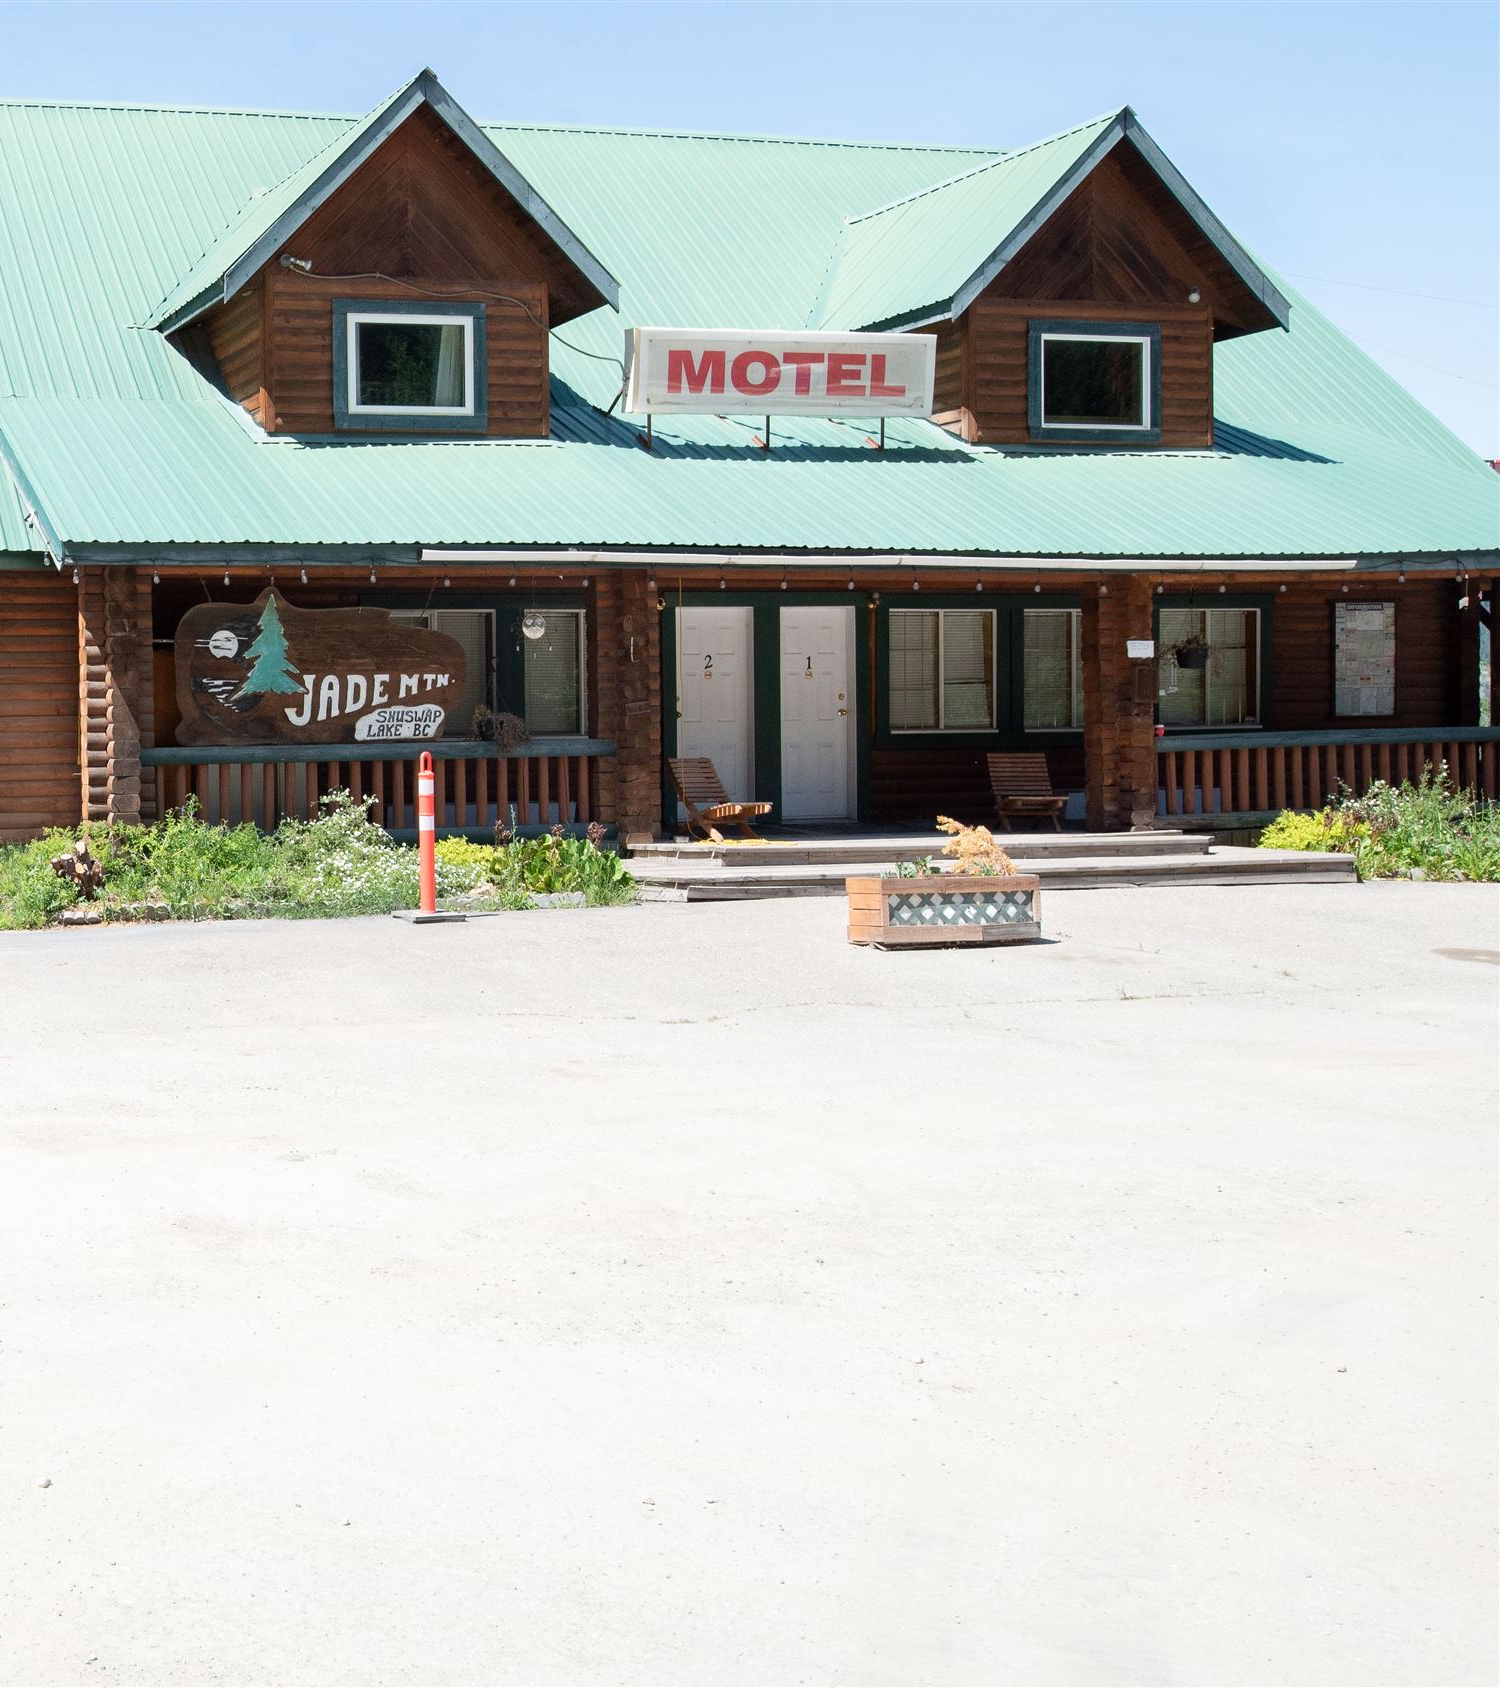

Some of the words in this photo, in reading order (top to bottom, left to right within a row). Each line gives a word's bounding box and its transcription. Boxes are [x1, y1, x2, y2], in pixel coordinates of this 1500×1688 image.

[667, 349, 906, 397] MOTEL
[704, 654, 713, 670] 2
[806, 655, 813, 670] 1
[284, 674, 390, 727] JADE
[375, 708, 442, 723] SHUSWAP
[366, 723, 403, 738] LAKE
[412, 723, 432, 737] BC
